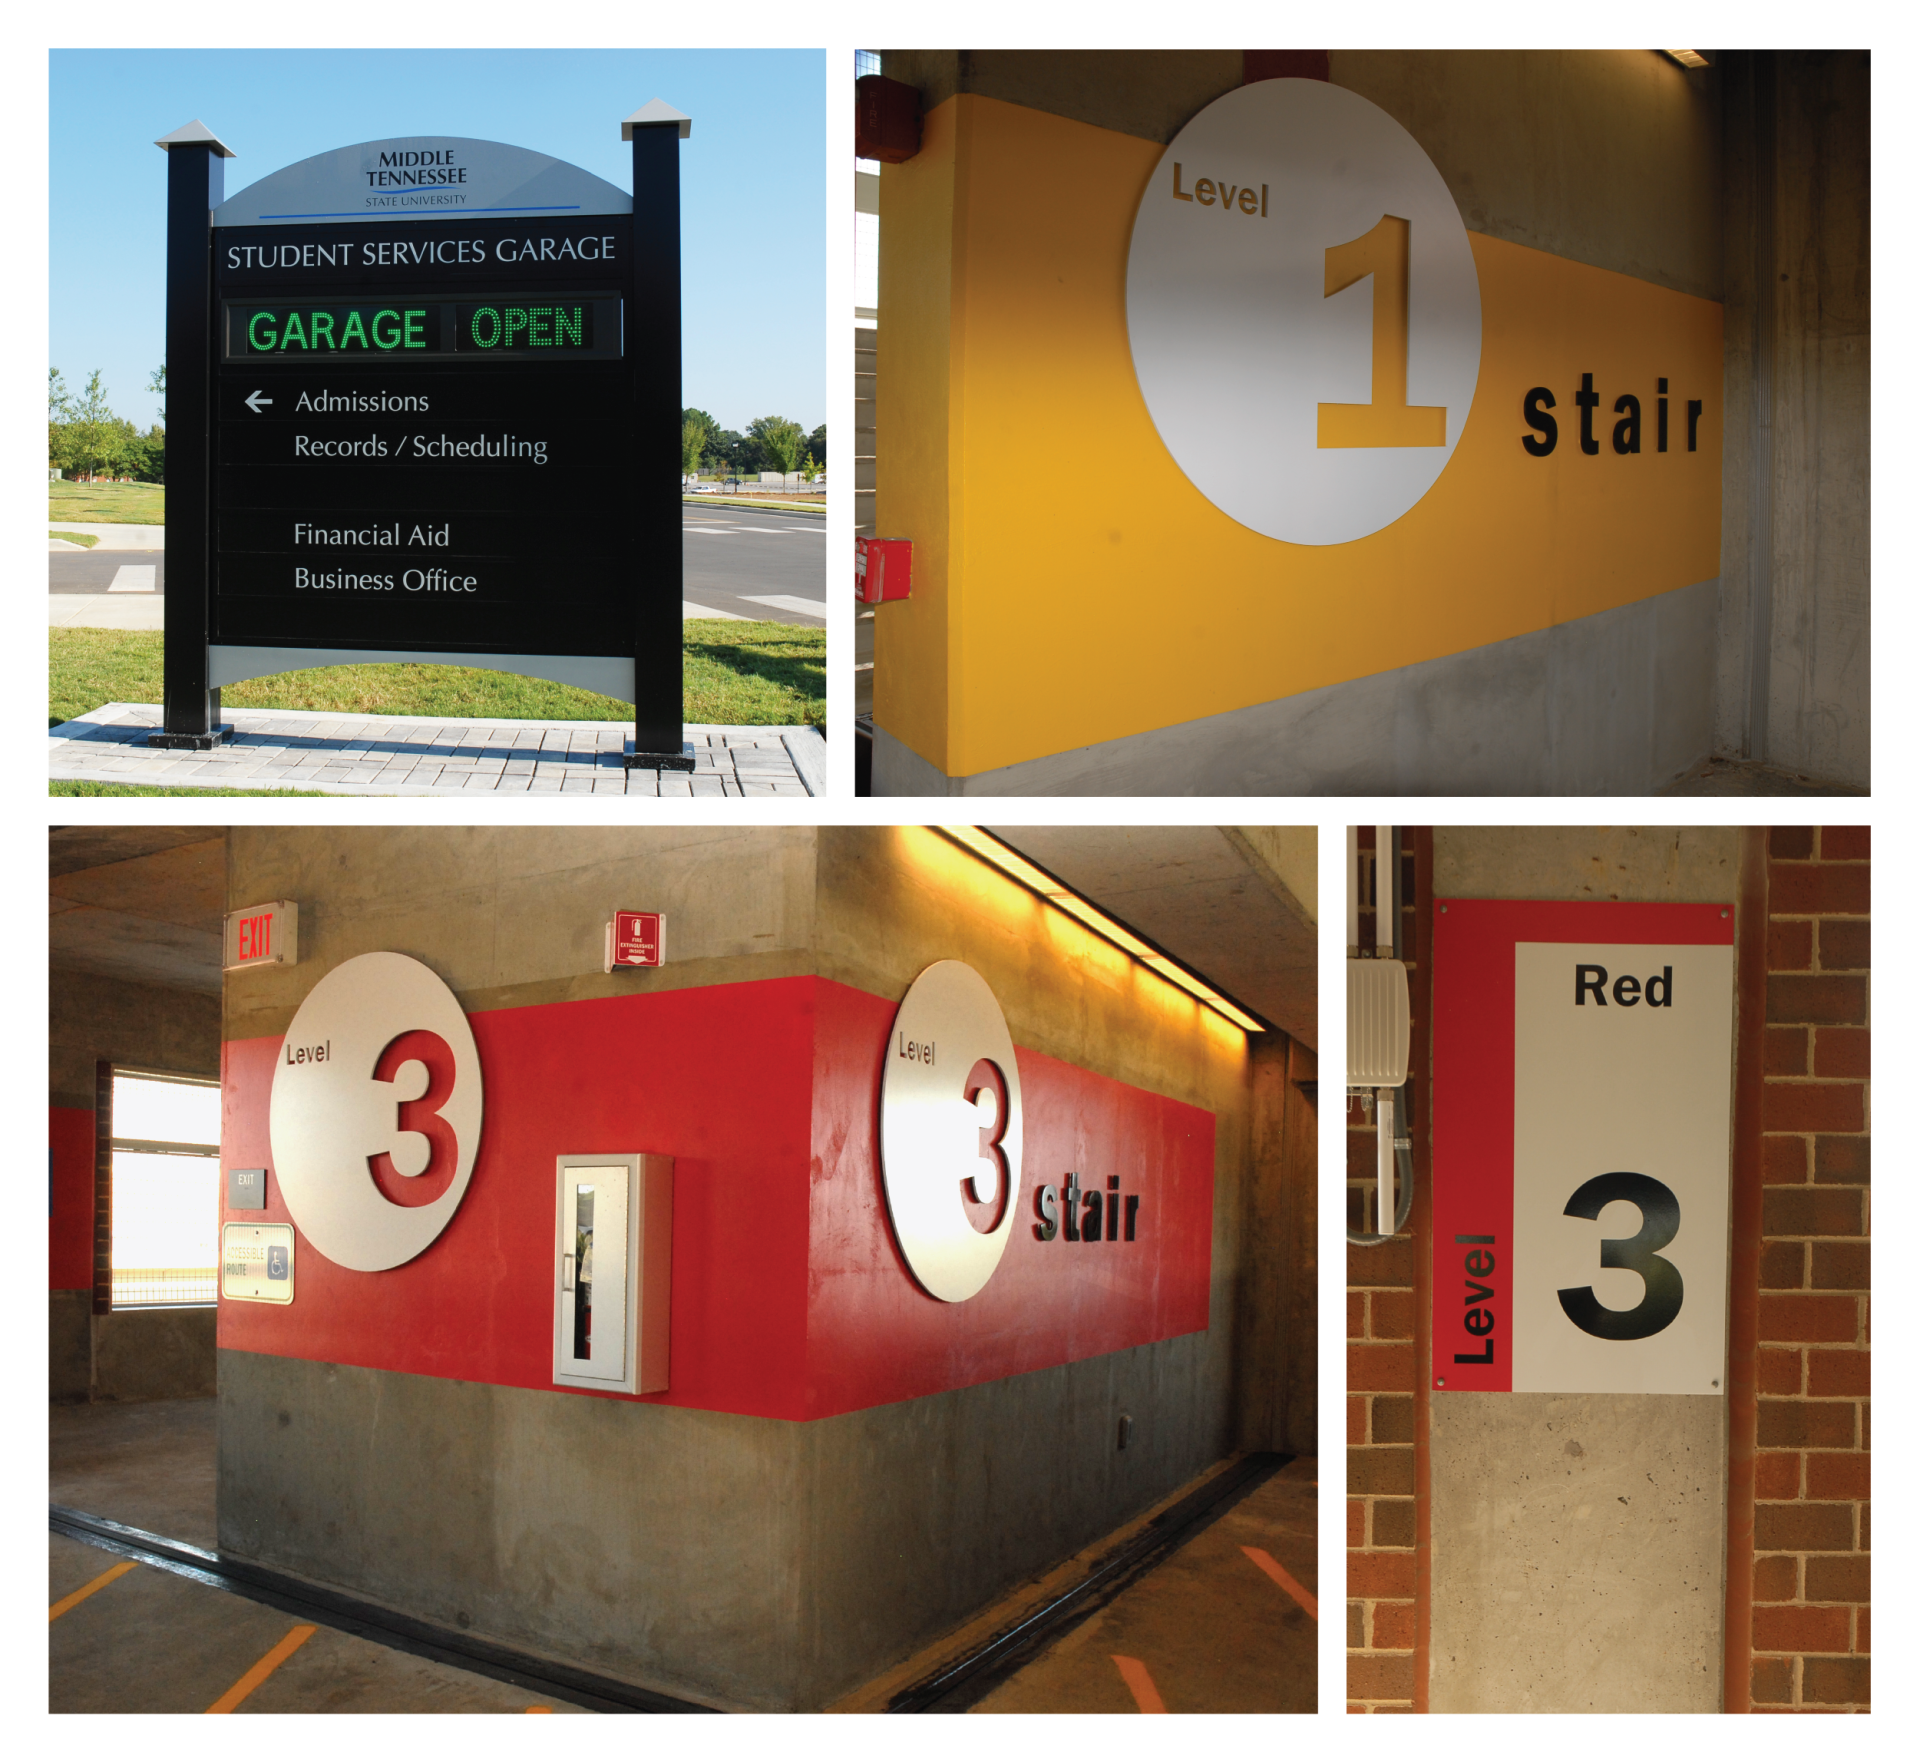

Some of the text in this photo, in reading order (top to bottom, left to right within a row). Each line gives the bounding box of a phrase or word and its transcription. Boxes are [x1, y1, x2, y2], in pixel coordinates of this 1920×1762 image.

[869, 91, 878, 128] FIRE
[378, 150, 454, 168] MIDDLE
[366, 168, 467, 187] TENNESSEE
[1172, 162, 1269, 218] Level
[365, 194, 467, 207] STATE UNIVERSITY
[227, 236, 616, 269] STUDENT SERVICES GARAGE
[248, 306, 583, 351] GARAGE OPEN
[1316, 213, 1448, 449] 1
[295, 390, 430, 412] Admissions
[1521, 372, 1702, 457] stair
[295, 434, 548, 465] Records / Scheduling
[294, 523, 450, 547] Financial Aid
[295, 567, 478, 592] Business Office
[239, 913, 273, 961] EXIT
[1575, 964, 1673, 1007] Red
[286, 1040, 331, 1065] Level
[899, 1031, 935, 1066] Level
[366, 1029, 459, 1208] 3
[959, 1058, 1012, 1235] 3
[238, 1174, 254, 1185] EXIT
[1033, 1172, 1140, 1242] stair
[226, 1247, 264, 1260] ACCESSIBLE
[226, 1263, 247, 1276] ROUTE
[1557, 1171, 1684, 1341] 3
[1454, 1235, 1496, 1364] Level
